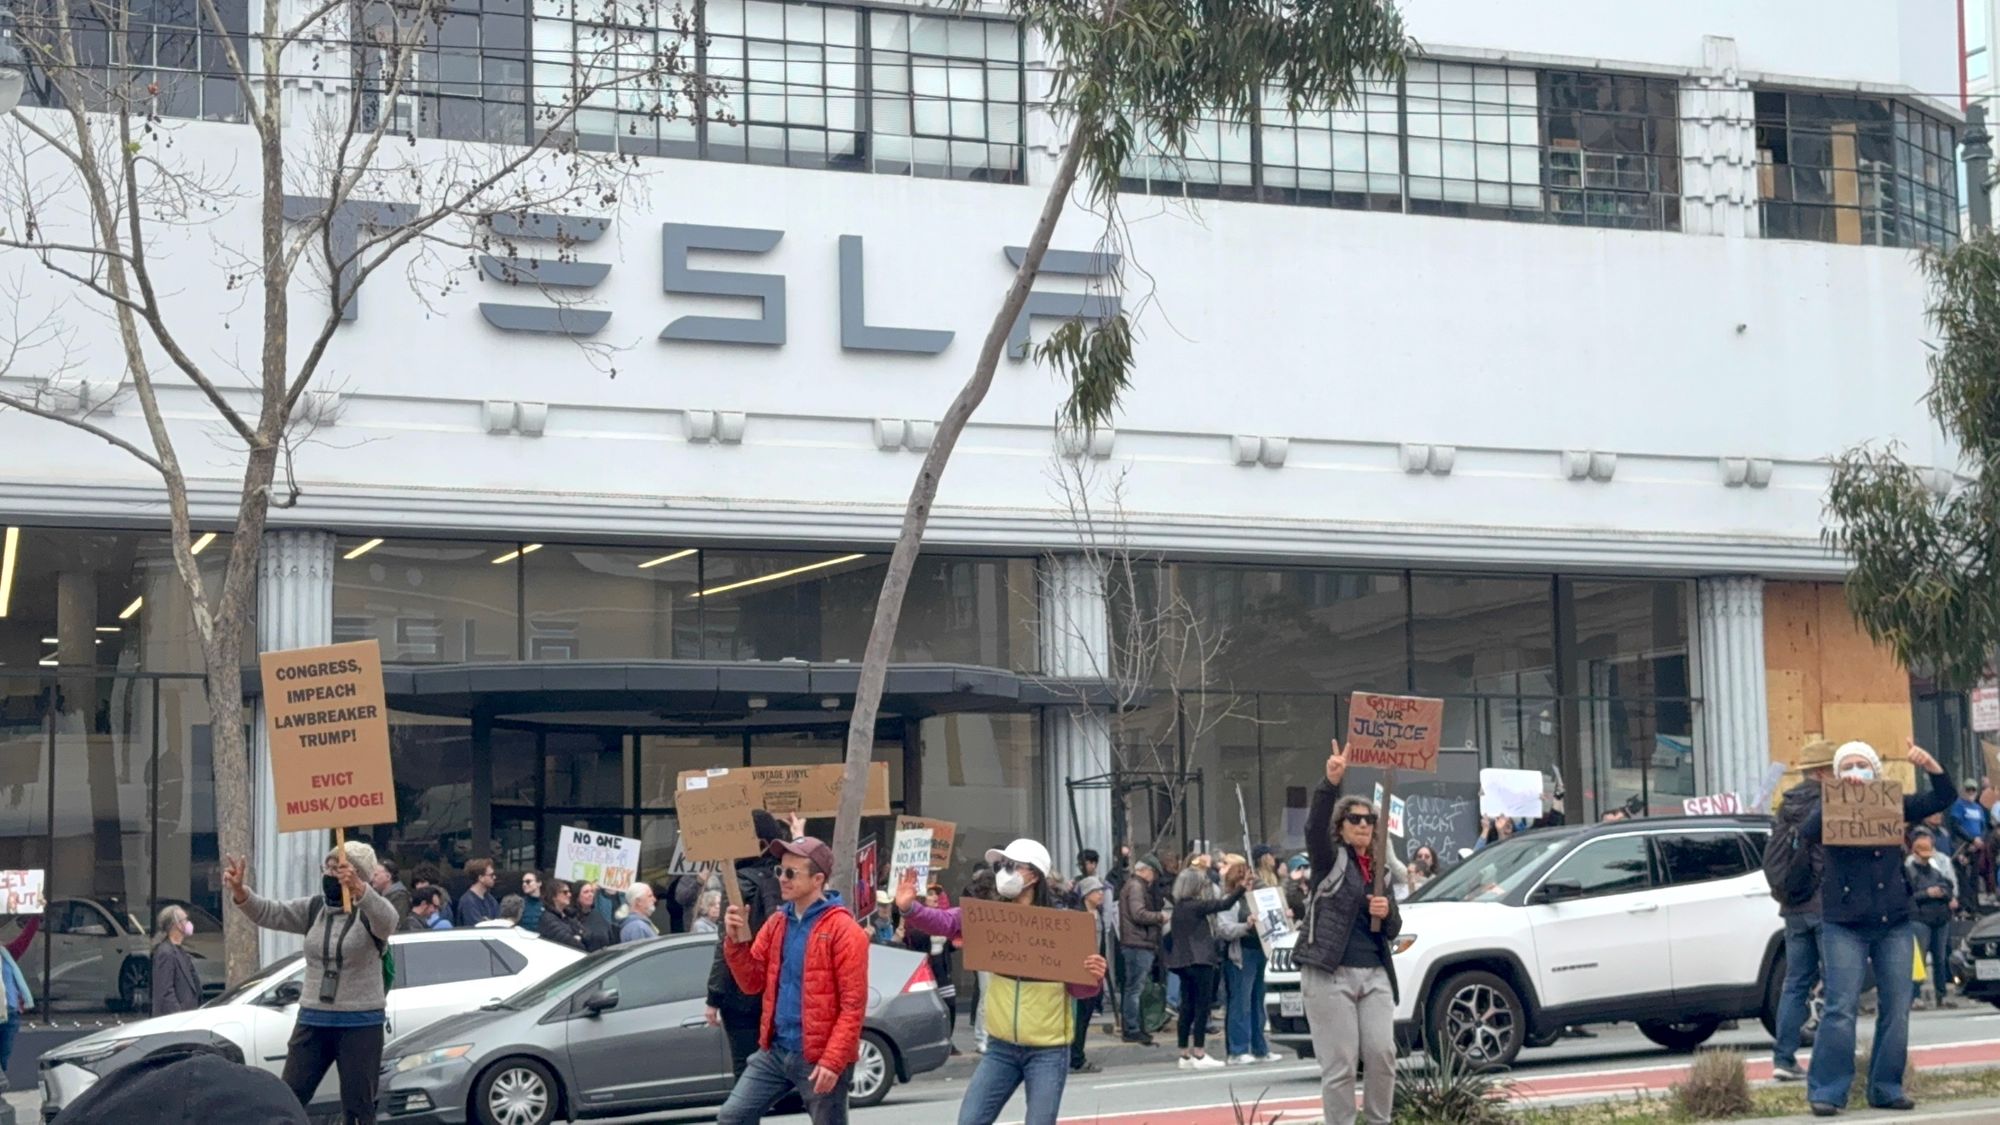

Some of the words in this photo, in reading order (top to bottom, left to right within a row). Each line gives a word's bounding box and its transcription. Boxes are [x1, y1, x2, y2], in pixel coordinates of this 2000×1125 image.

[268, 194, 1122, 359] TESLA
[276, 659, 362, 681] CONGRESS,
[287, 683, 356, 703] IMPEACH
[1366, 696, 1418, 712] GATHER
[275, 705, 377, 729] LAWBREAKER
[1376, 709, 1403, 720] YOUR
[299, 729, 357, 748] TRUMP!
[1353, 718, 1428, 740] JUSTICE
[1373, 739, 1397, 750] AND
[1350, 748, 1435, 770] HUMANITY
[311, 772, 354, 788] EVICT
[752, 770, 784, 780] VINTAGE
[786, 769, 808, 780] VINYL
[1824, 779, 1897, 807] MUSK
[287, 792, 384, 815] MUSK/DOGE!
[1687, 793, 1738, 815] SEND
[1825, 819, 1902, 840] STEALING
[573, 832, 591, 844] NO
[596, 835, 622, 849] ONE
[899, 839, 912, 849] NO
[896, 852, 909, 863] NO
[967, 907, 1071, 932] BILLIONAIRES
[1029, 937, 1056, 949] CARE
[991, 951, 1027, 961] ABOUT
[1040, 955, 1061, 967] YOU
